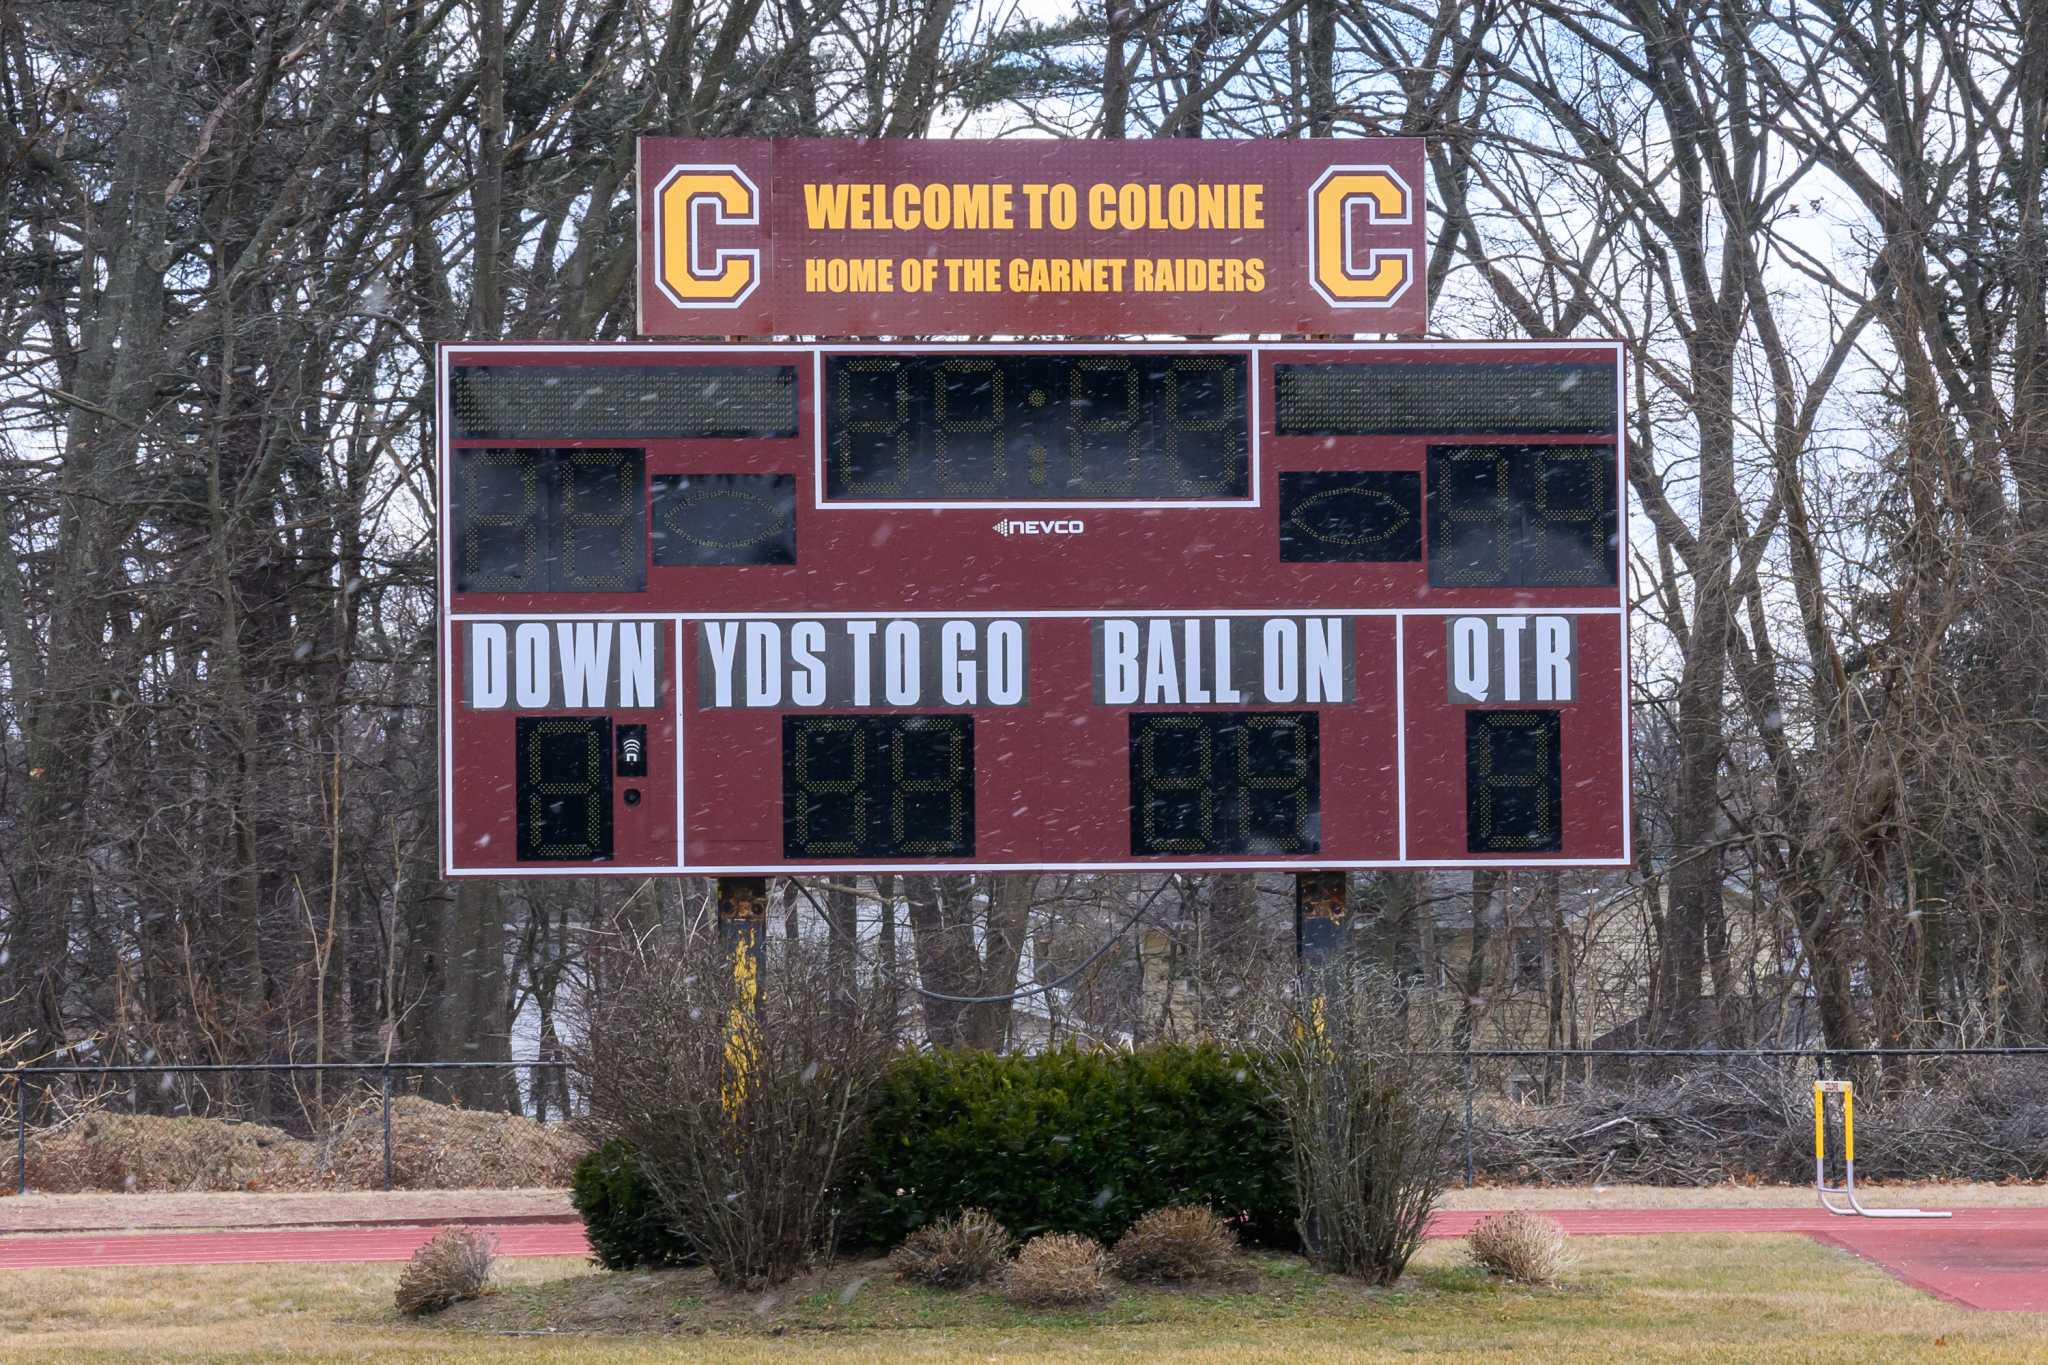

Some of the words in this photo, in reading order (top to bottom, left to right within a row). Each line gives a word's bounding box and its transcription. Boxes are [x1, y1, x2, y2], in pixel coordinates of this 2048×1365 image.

[654, 163, 761, 310] C
[803, 182, 1014, 231] WELCOME
[1024, 182, 1078, 231] TO
[1088, 182, 1265, 231] COLONIE
[1307, 164, 1414, 309] C
[805, 258, 893, 293] HOME
[900, 258, 938, 293] OF
[944, 258, 1002, 293] THE
[1008, 257, 1128, 293] GARNET
[1133, 257, 1266, 293] RAIDERS
[471, 622, 656, 709] DOWN
[704, 620, 828, 708] YDS
[846, 620, 921, 706] TO
[941, 620, 1023, 706] GO
[1103, 618, 1240, 705] BALL
[1263, 617, 1343, 703] ON
[1453, 616, 1572, 702] QTR
